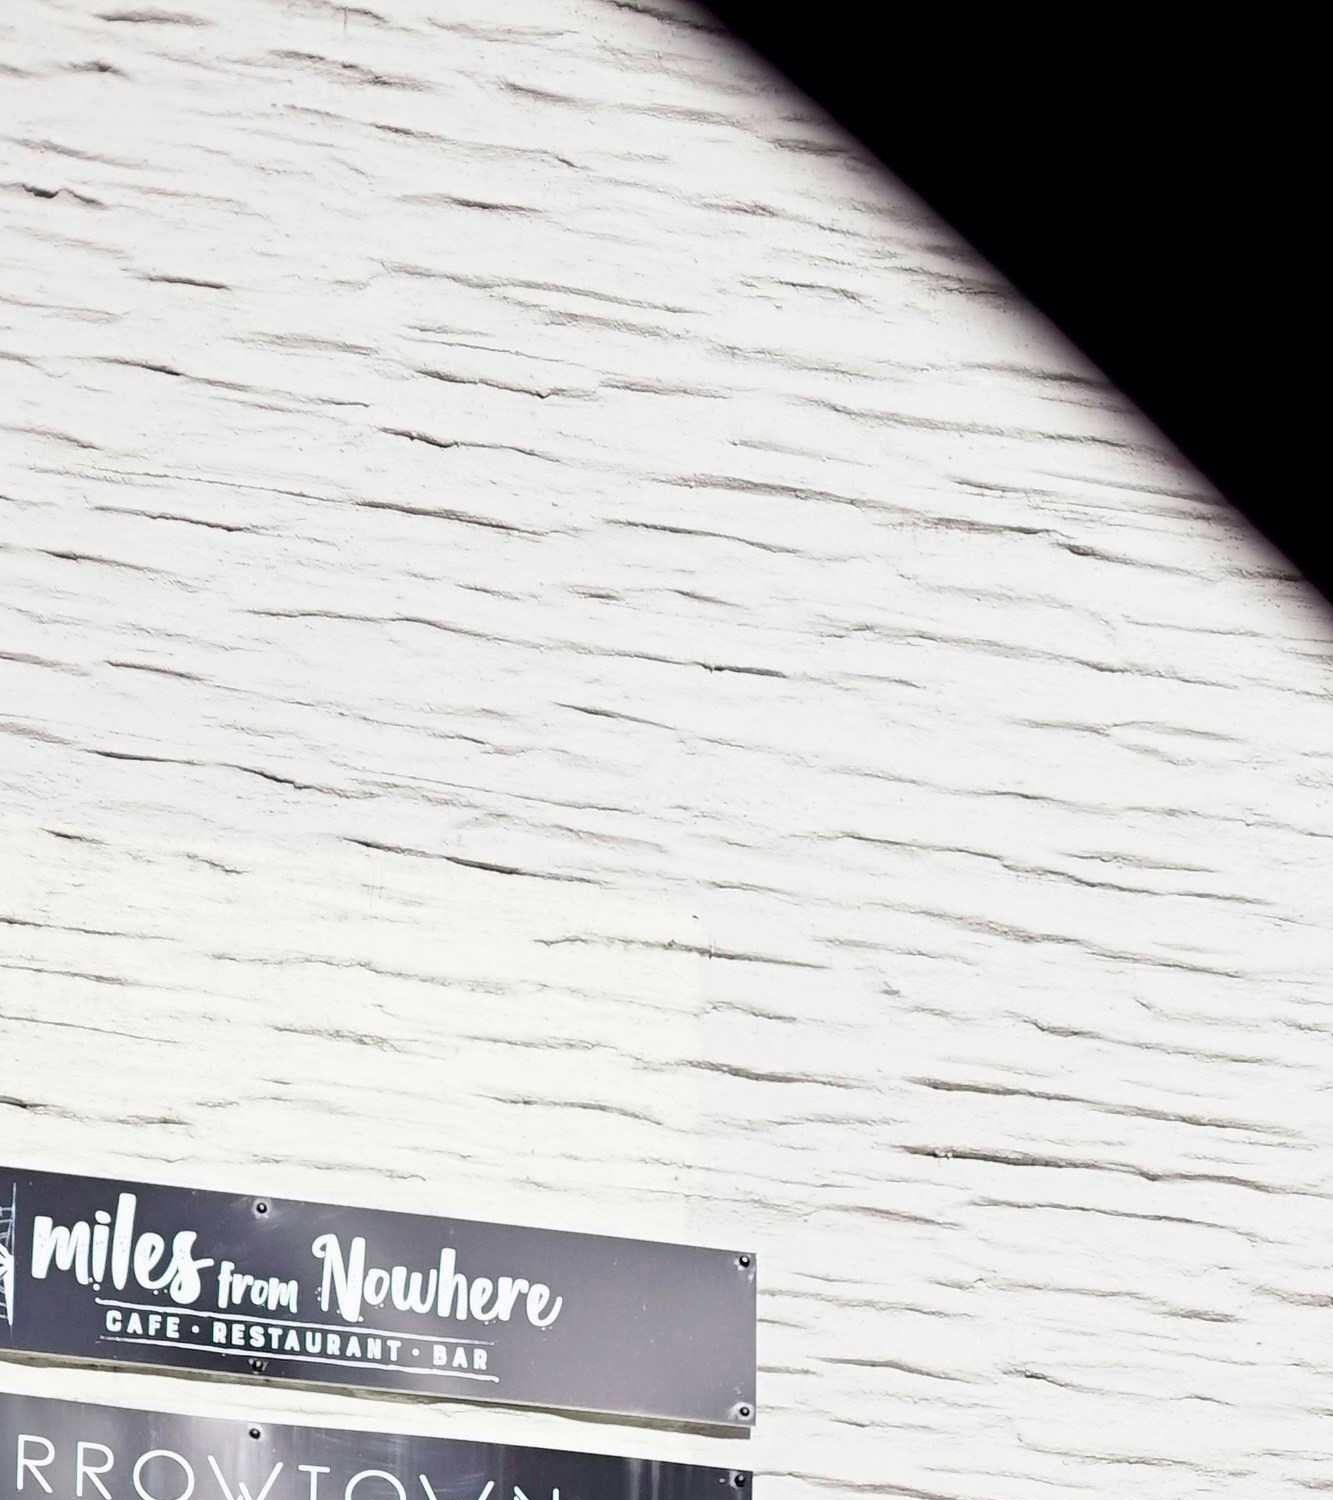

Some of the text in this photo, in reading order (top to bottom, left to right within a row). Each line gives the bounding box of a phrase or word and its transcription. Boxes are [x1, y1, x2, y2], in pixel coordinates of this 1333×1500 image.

[31, 1192, 562, 1328] miles from Nowhere
[105, 1310, 490, 1372] CAFE RESTAURANT BAR
